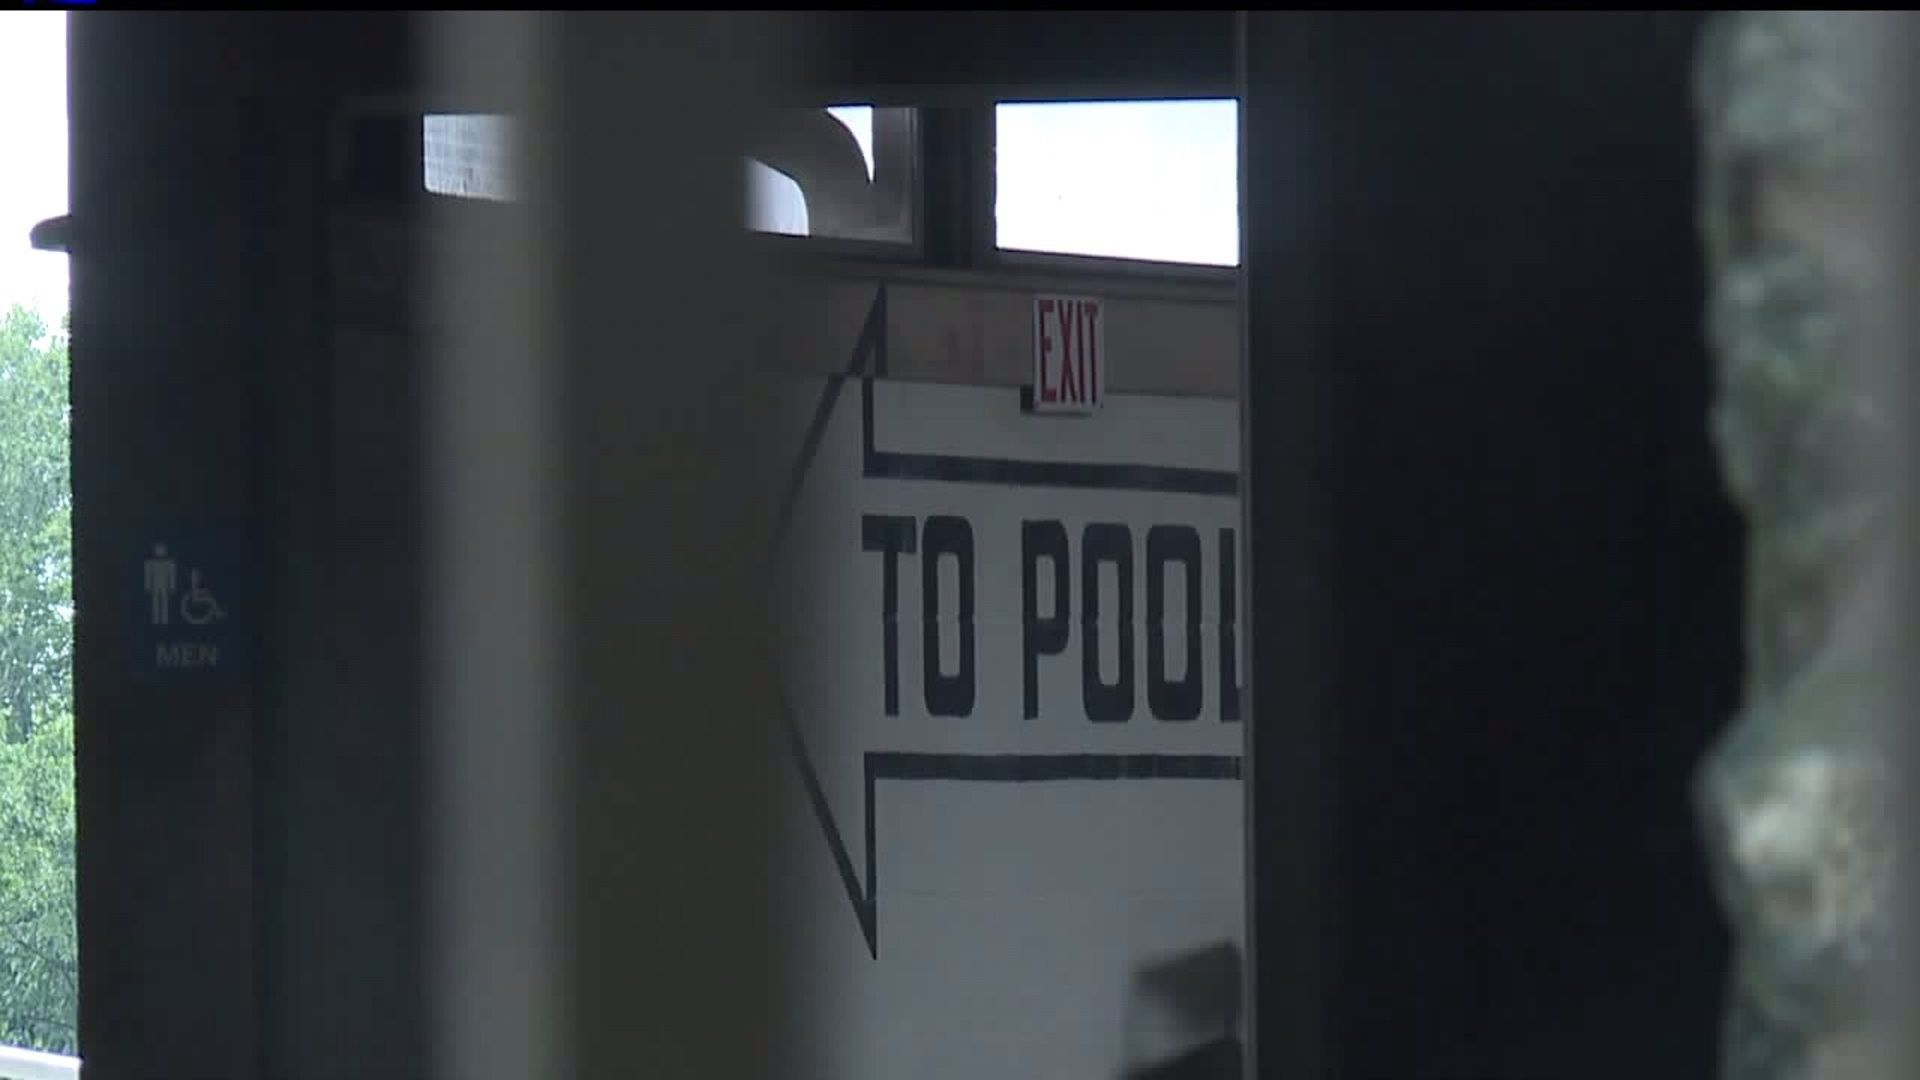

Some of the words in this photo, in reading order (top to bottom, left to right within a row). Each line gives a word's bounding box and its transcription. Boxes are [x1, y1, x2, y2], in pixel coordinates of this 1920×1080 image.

[1038, 299, 1098, 404] EXIT
[155, 643, 218, 668] MEN
[862, 515, 975, 717] TO
